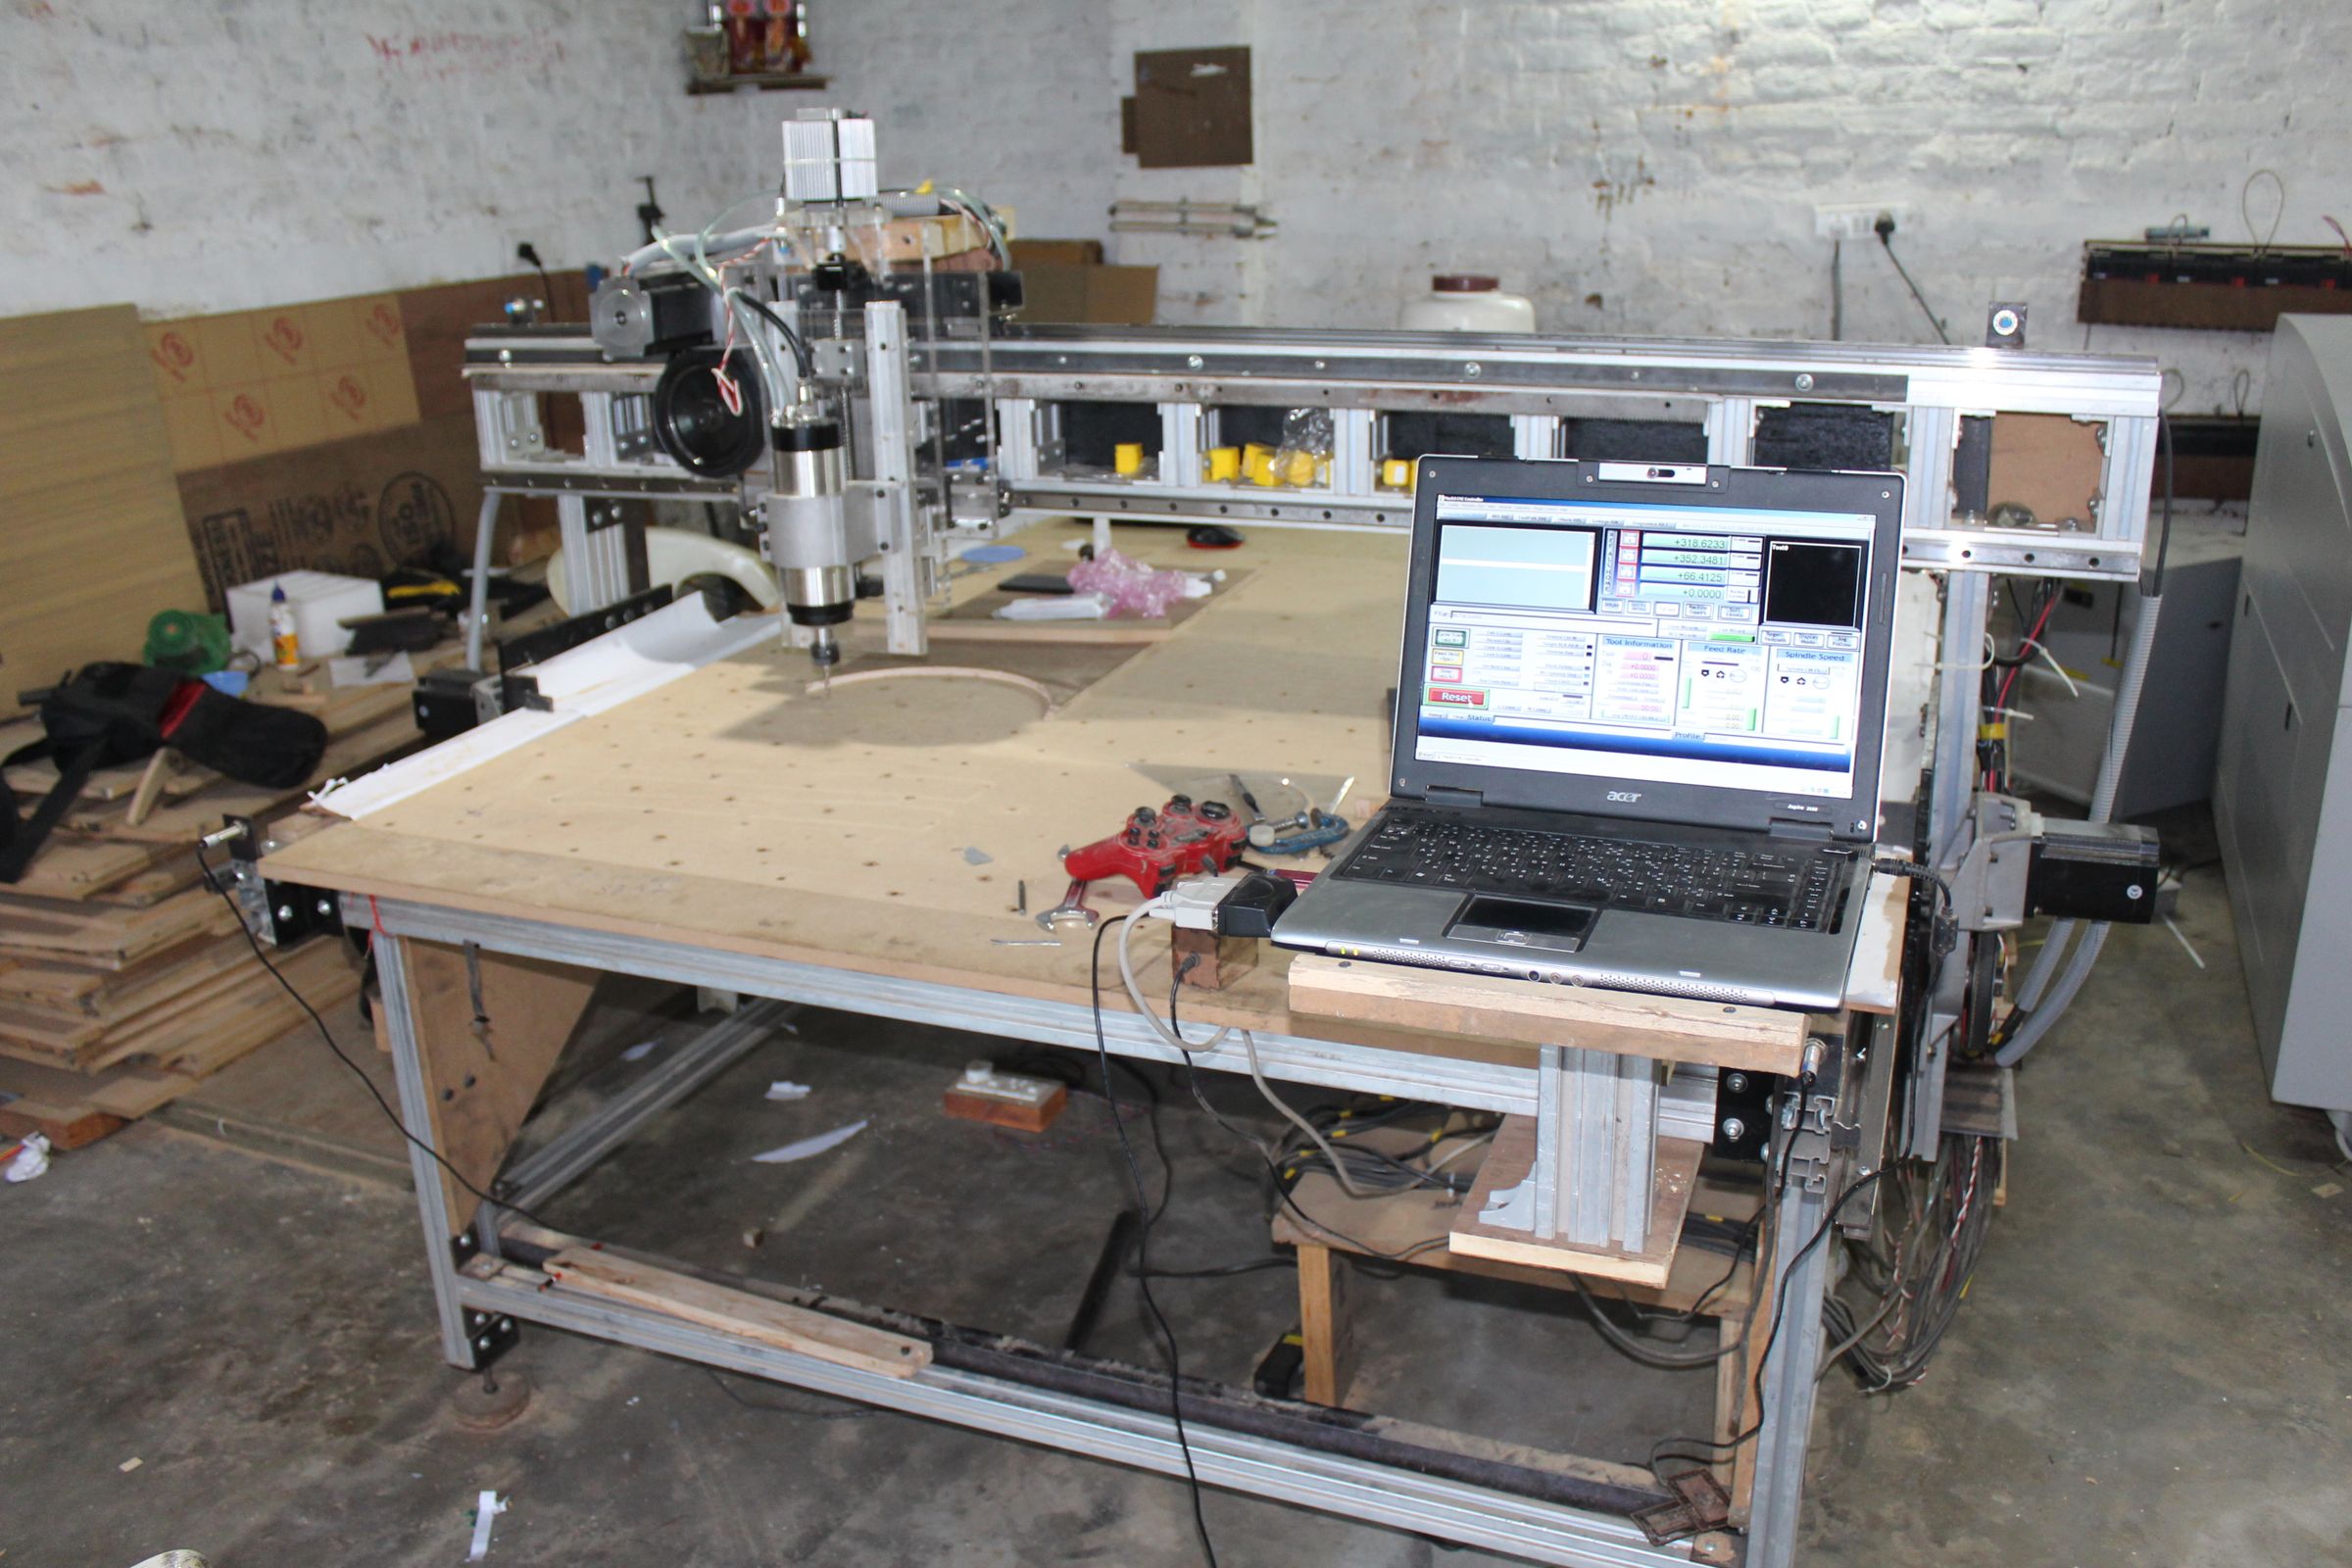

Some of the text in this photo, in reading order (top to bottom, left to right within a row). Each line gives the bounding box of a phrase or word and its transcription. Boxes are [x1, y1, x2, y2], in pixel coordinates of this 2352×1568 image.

[1676, 539, 1726, 548] +318.6233
[1674, 555, 1724, 564] +352.3481
[1678, 571, 1723, 581] +66.4125
[1684, 588, 1721, 598] +0.0000
[1625, 639, 1672, 649] Information
[1786, 651, 1816, 660] Spindle
[1442, 692, 1472, 703] Reset
[1607, 791, 1642, 803] acer
